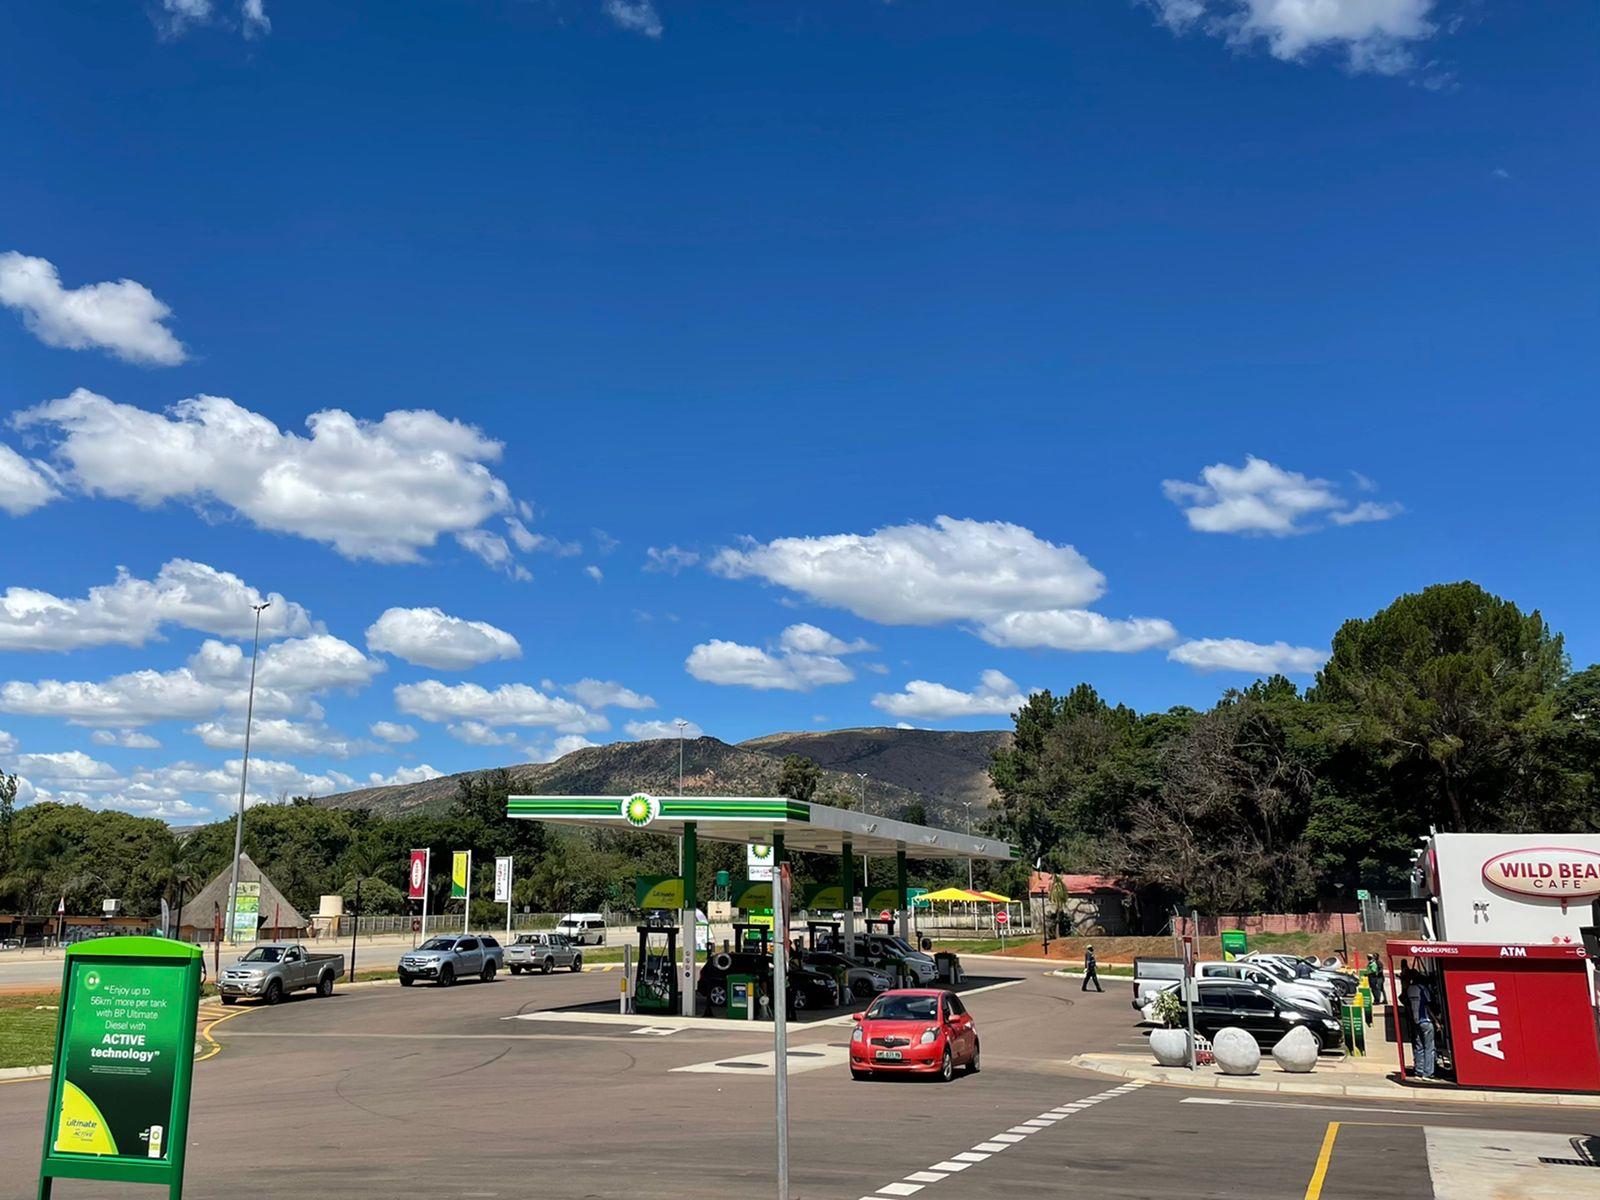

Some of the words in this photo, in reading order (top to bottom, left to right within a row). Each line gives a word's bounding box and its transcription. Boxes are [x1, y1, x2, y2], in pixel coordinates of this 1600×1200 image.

[1500, 862, 1553, 878] WILD
[1558, 863, 1600, 878] BEA
[1533, 879, 1581, 889] CAFE
[1500, 947, 1527, 957] ATM
[130, 987, 141, 996] up
[142, 987, 150, 995] to
[135, 999, 149, 1008] per
[150, 999, 167, 1008] tank
[96, 1008, 113, 1017] with
[113, 1009, 126, 1018] BP
[126, 1010, 159, 1020] Ultimate
[104, 1020, 128, 1030] Diesel
[129, 1022, 146, 1031] with
[1465, 982, 1505, 1060] ATM
[102, 1033, 146, 1046] ACTIVE
